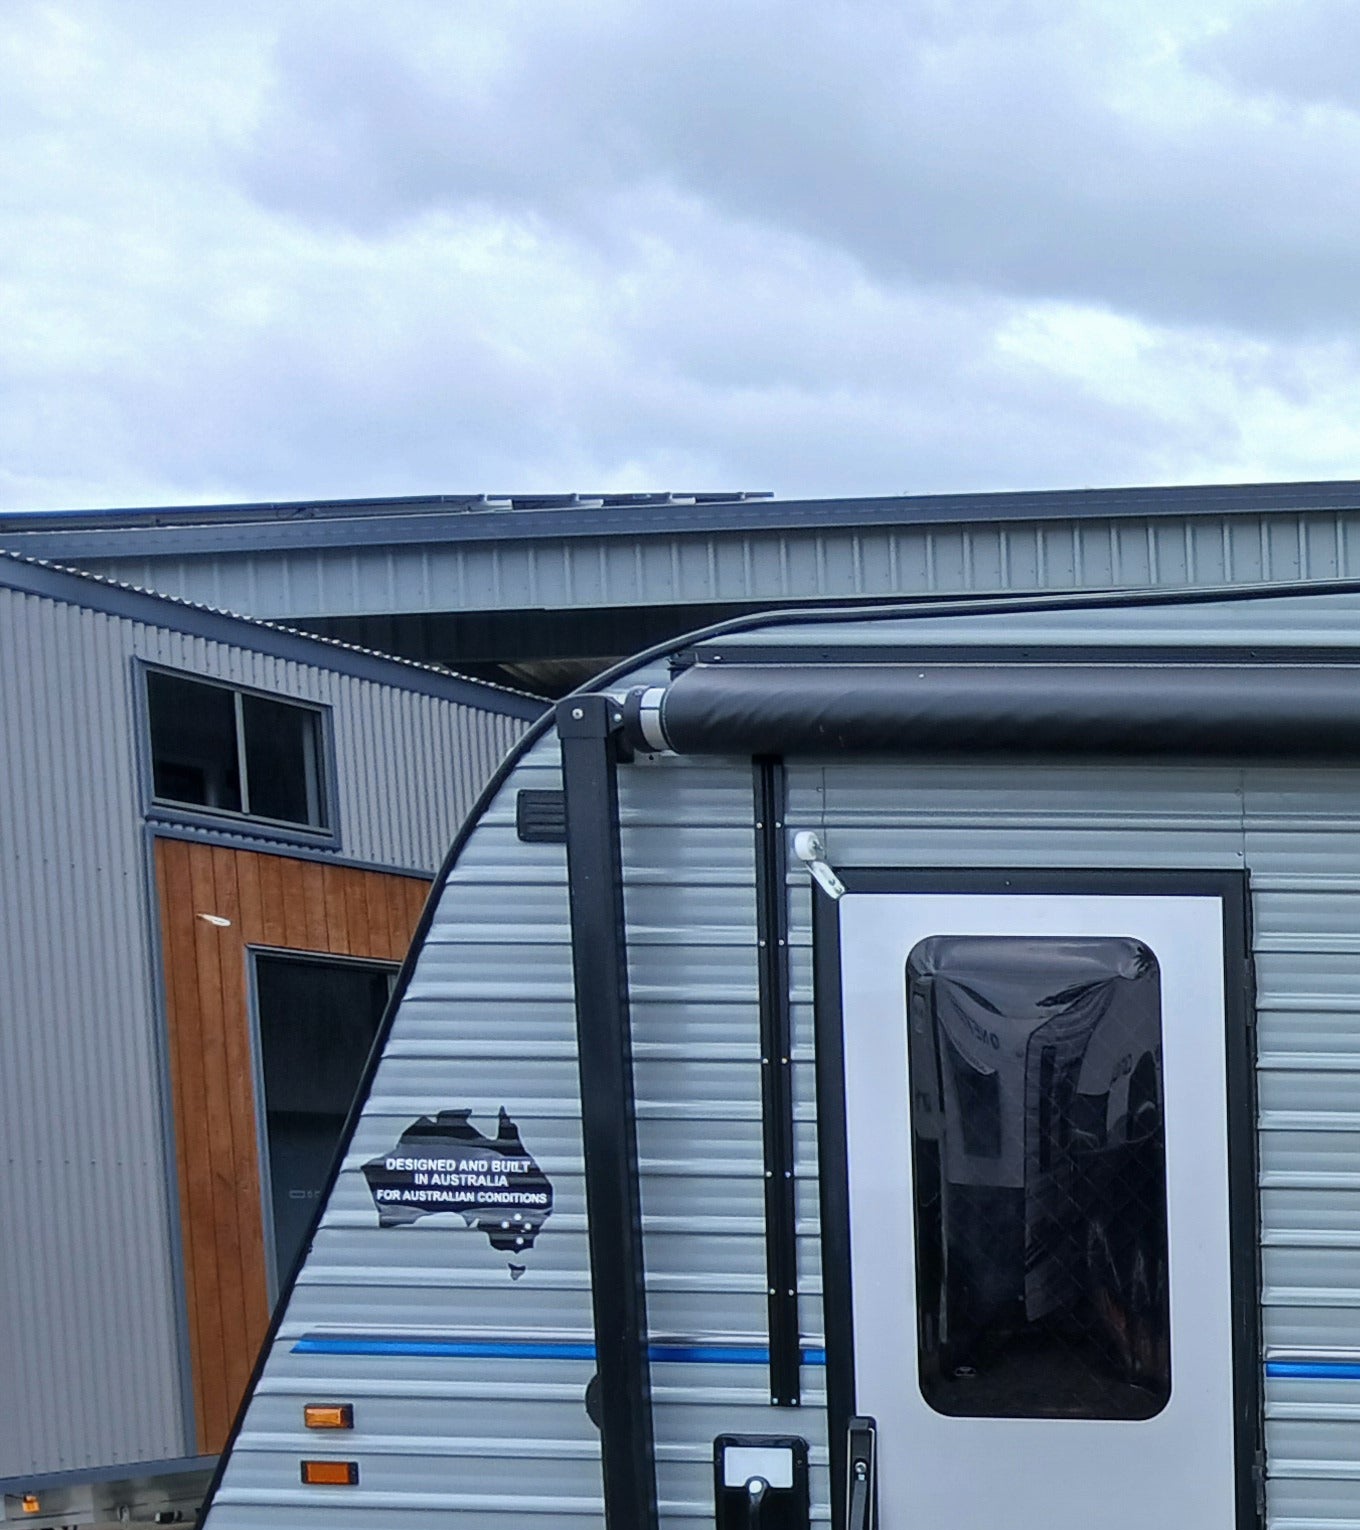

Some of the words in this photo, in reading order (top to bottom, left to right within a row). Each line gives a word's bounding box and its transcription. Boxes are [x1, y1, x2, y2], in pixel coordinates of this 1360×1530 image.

[386, 1158, 456, 1172] DESIGNED
[459, 1159, 488, 1172] AND
[491, 1160, 531, 1173] BUILT
[414, 1173, 429, 1185] IN
[431, 1173, 509, 1187] AUSTRALIA
[376, 1189, 401, 1200] FOR
[402, 1190, 475, 1202] AUSTRALIAN
[477, 1191, 548, 1204] CONDITIONS
